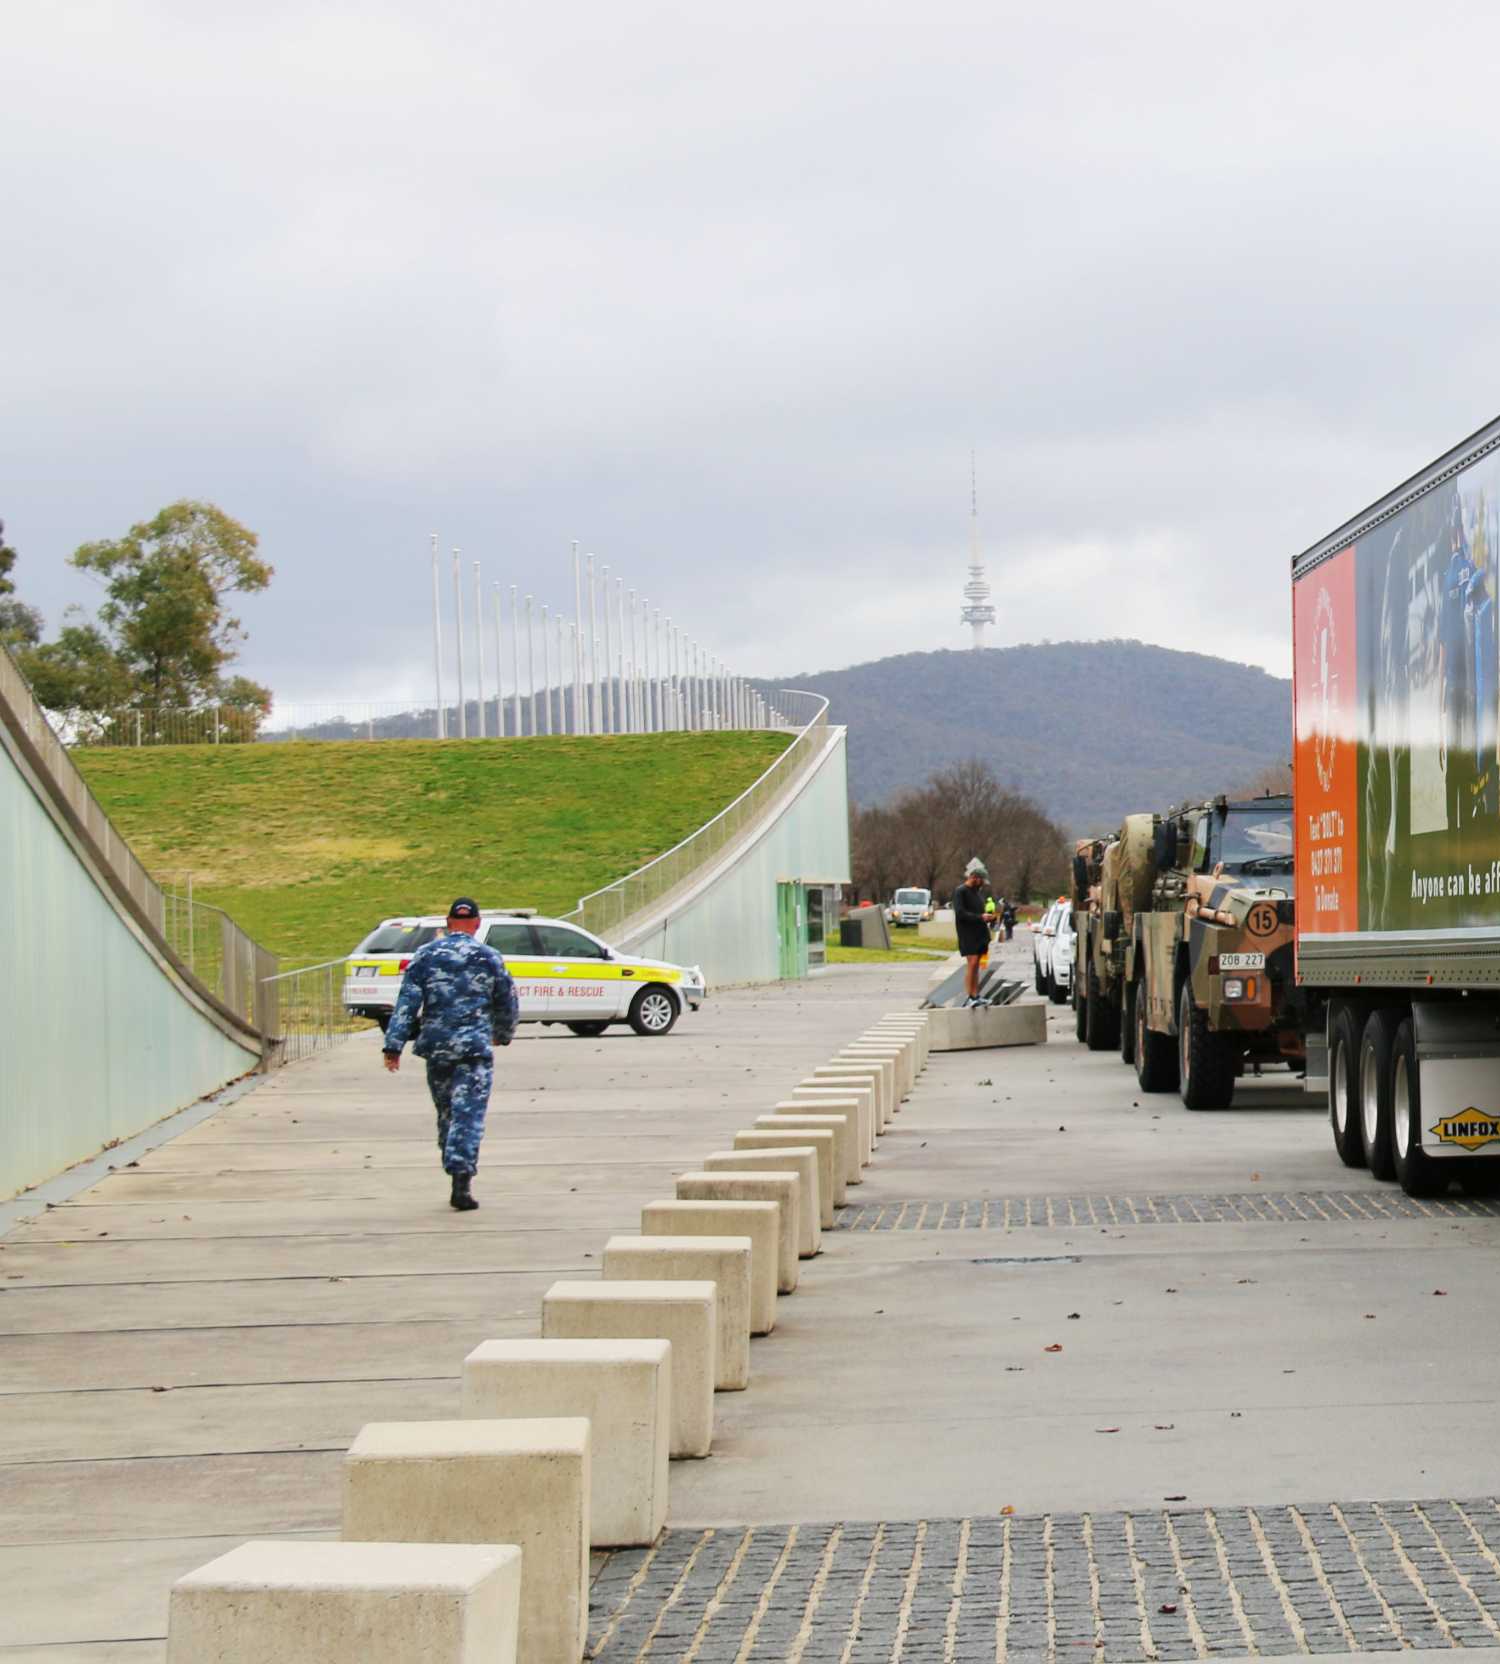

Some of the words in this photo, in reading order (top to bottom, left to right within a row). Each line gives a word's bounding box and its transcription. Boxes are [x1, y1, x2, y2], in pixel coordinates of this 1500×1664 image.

[1411, 869, 1444, 904] Anyone
[1448, 875, 1464, 897] can
[1468, 864, 1481, 896] be
[1254, 910, 1272, 930] 15
[1246, 954, 1263, 966] 227
[534, 986, 554, 997] FIRE
[558, 986, 565, 997] &
[568, 986, 605, 997] RESCUE
[1444, 1121, 1499, 1137] LINFOX
